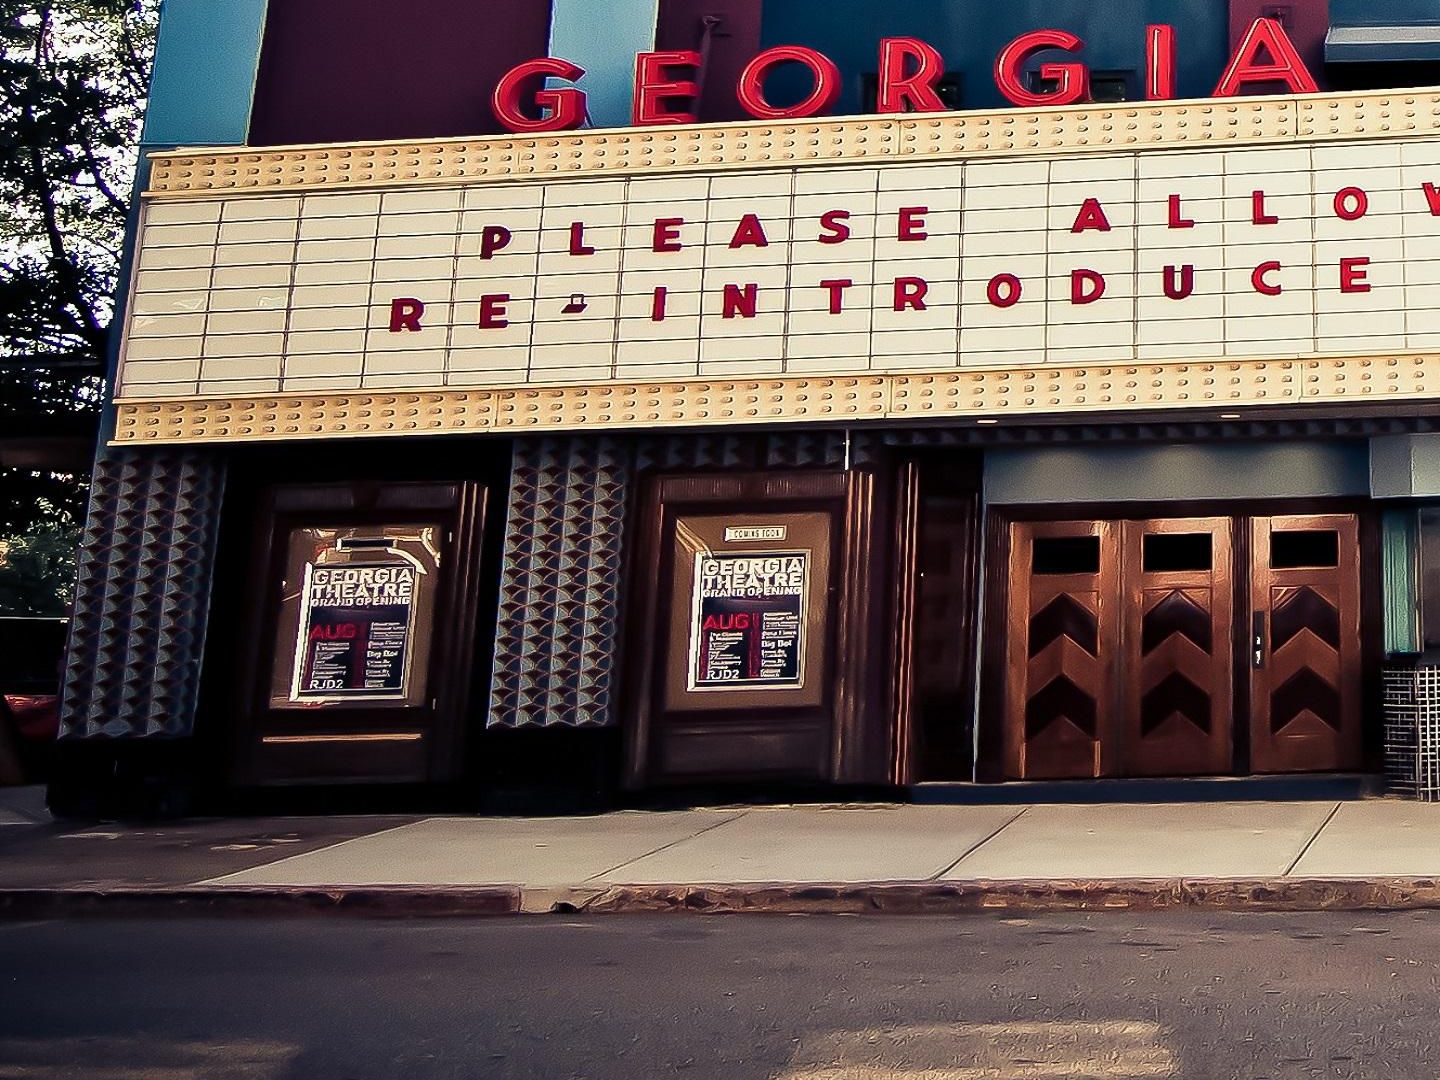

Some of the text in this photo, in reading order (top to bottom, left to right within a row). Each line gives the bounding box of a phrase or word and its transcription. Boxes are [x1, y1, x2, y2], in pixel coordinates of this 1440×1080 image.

[490, 17, 1321, 133] GEORGIA
[479, 206, 929, 260] PLEASE
[703, 557, 802, 576] GEORGIA
[313, 568, 414, 585] GEORGIA
[703, 573, 801, 589] THEATRE
[311, 583, 411, 599] THEATRE
[703, 587, 801, 598] GRAND OPENING
[311, 597, 410, 607] GRAND OPENING
[703, 613, 749, 630] AUG
[310, 624, 356, 640] AUG
[706, 670, 740, 680] RJD2
[310, 679, 344, 689] RJD2
